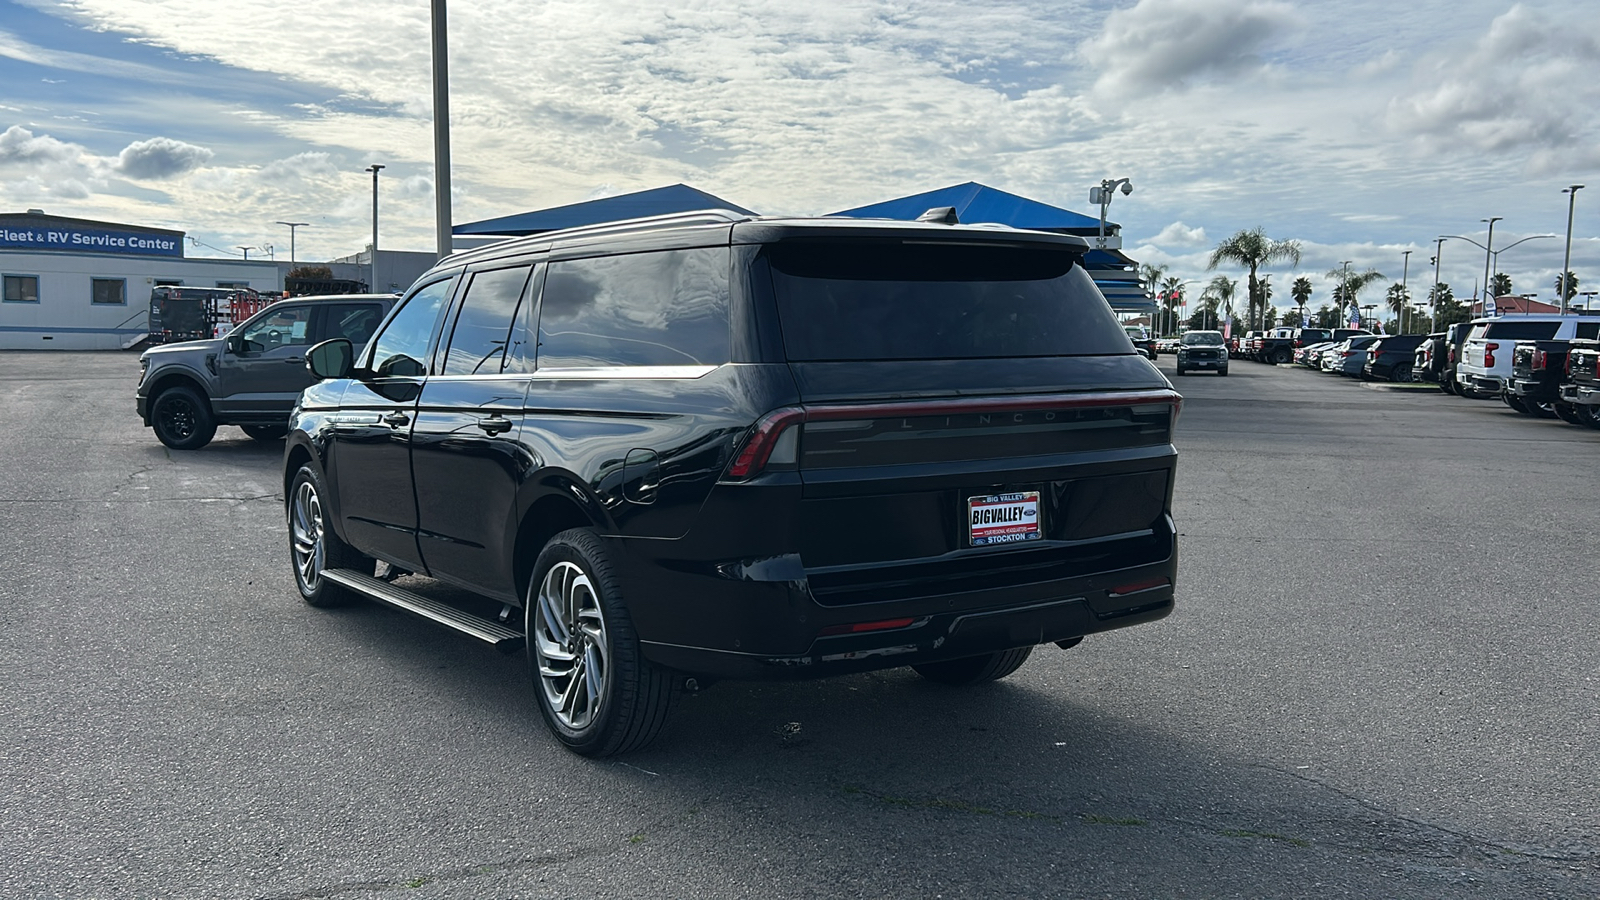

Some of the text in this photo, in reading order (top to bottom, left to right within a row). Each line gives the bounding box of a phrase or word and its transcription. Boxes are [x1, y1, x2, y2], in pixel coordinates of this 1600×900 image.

[36, 233, 44, 242] &
[48, 231, 69, 243] RV
[72, 233, 125, 246] Service
[128, 237, 175, 250] Center
[902, 409, 1115, 428] LINCOLN
[1000, 494, 1023, 502] VALLEY
[973, 506, 1024, 524] BIGVALLEY
[988, 533, 1025, 543] STOCKTON
